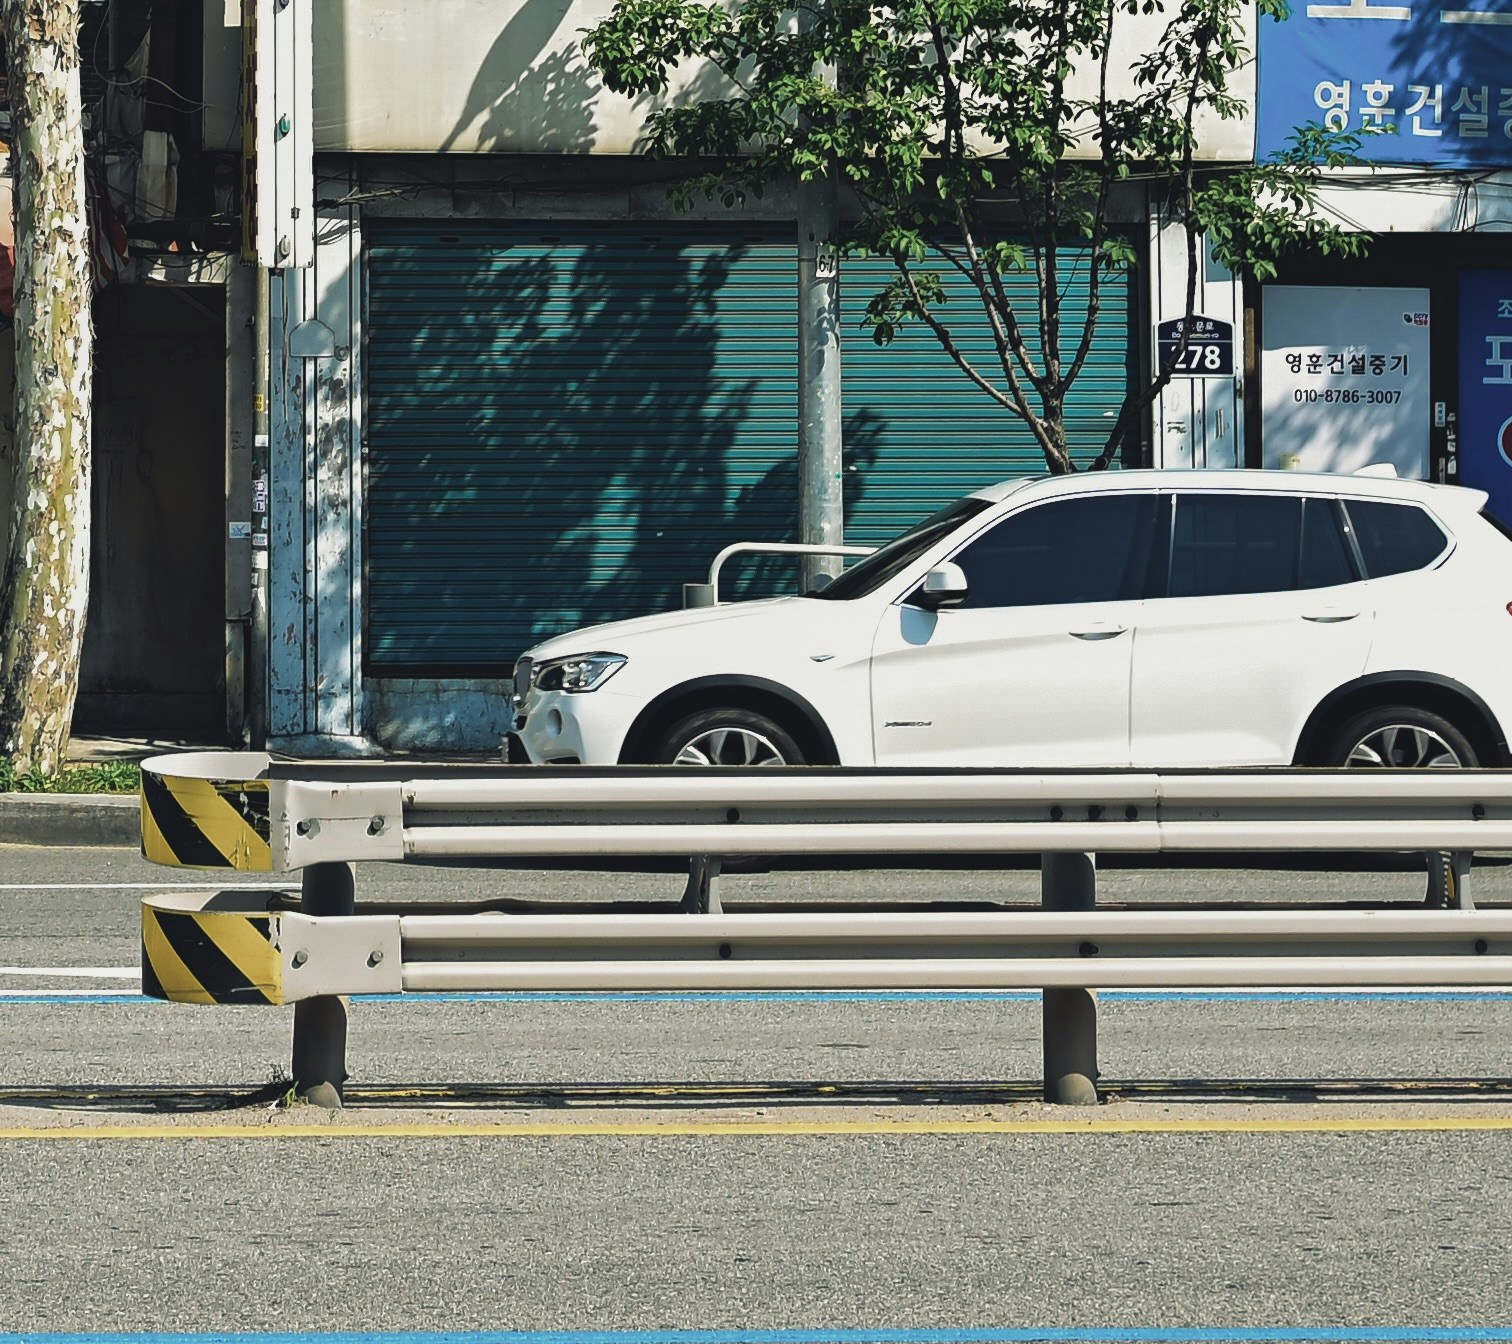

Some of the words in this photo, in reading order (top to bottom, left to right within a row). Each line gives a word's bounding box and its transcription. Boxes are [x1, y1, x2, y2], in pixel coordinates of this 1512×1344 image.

[1171, 345, 1221, 370] 278
[1285, 353, 1410, 377] 영훈건설중기
[1293, 388, 1403, 405] 010-8786-3007
